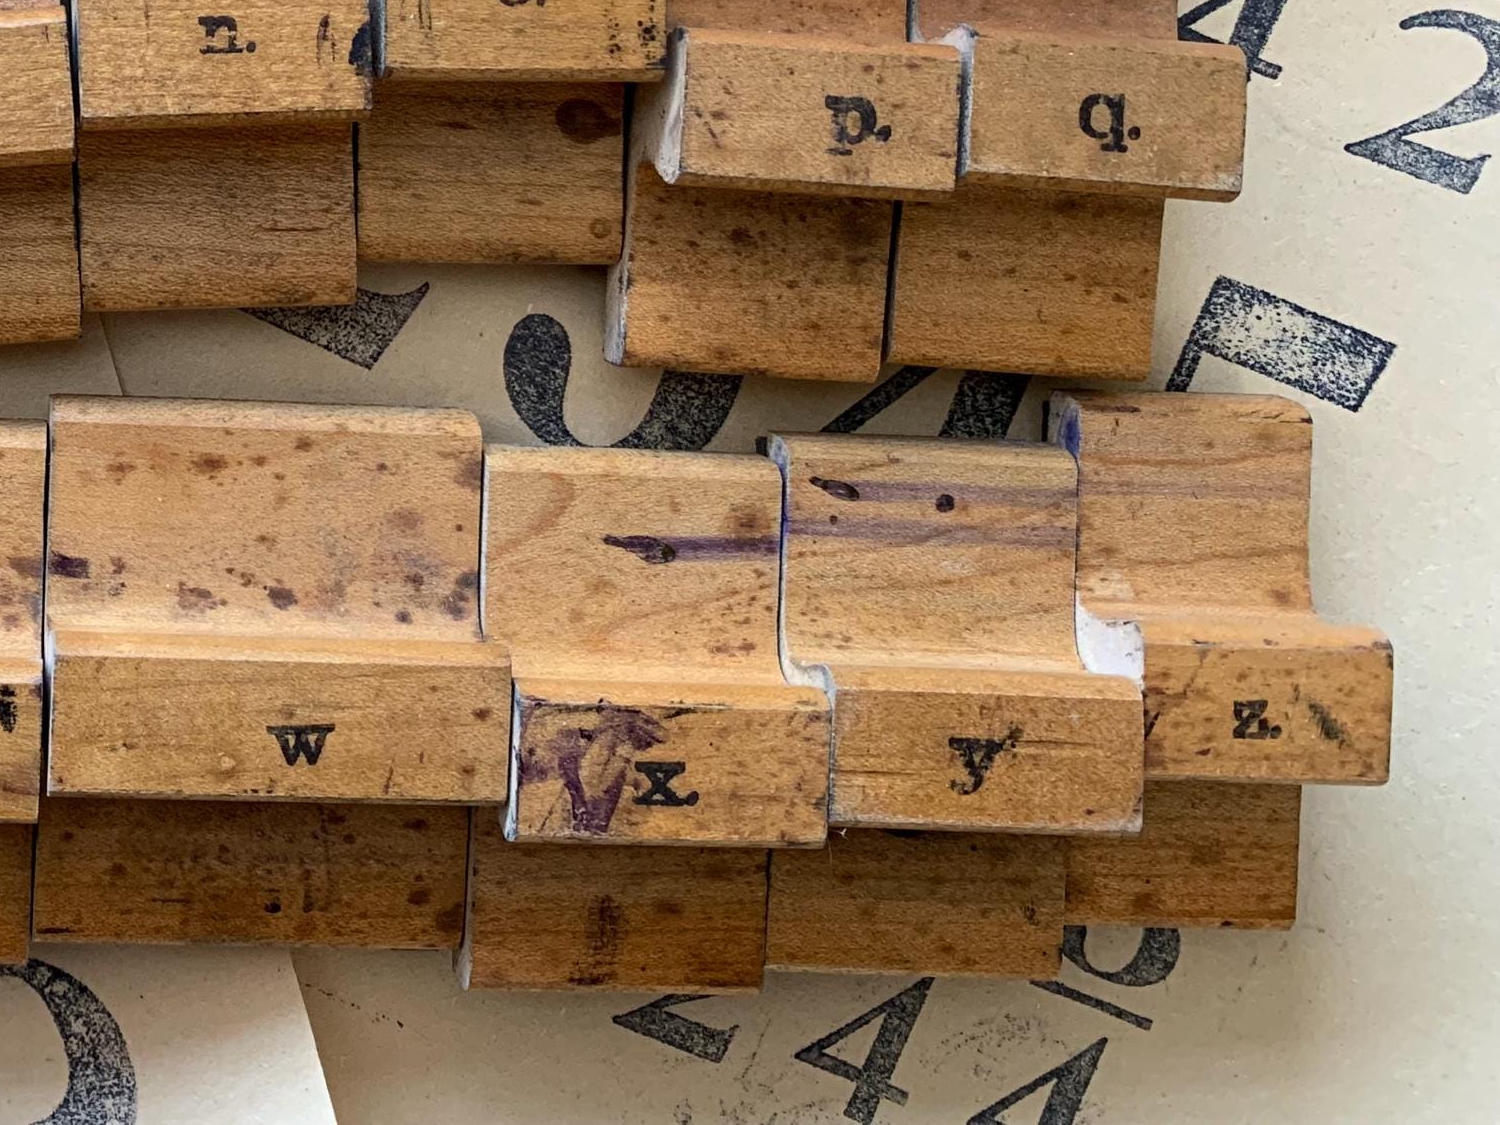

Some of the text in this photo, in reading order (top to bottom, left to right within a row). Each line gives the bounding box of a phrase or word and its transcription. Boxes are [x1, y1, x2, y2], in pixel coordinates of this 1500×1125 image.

[197, 15, 257, 55] n.
[824, 94, 893, 156] p.
[1079, 93, 1142, 154] q.
[1232, 700, 1283, 740] z.
[631, 760, 700, 807] x.
